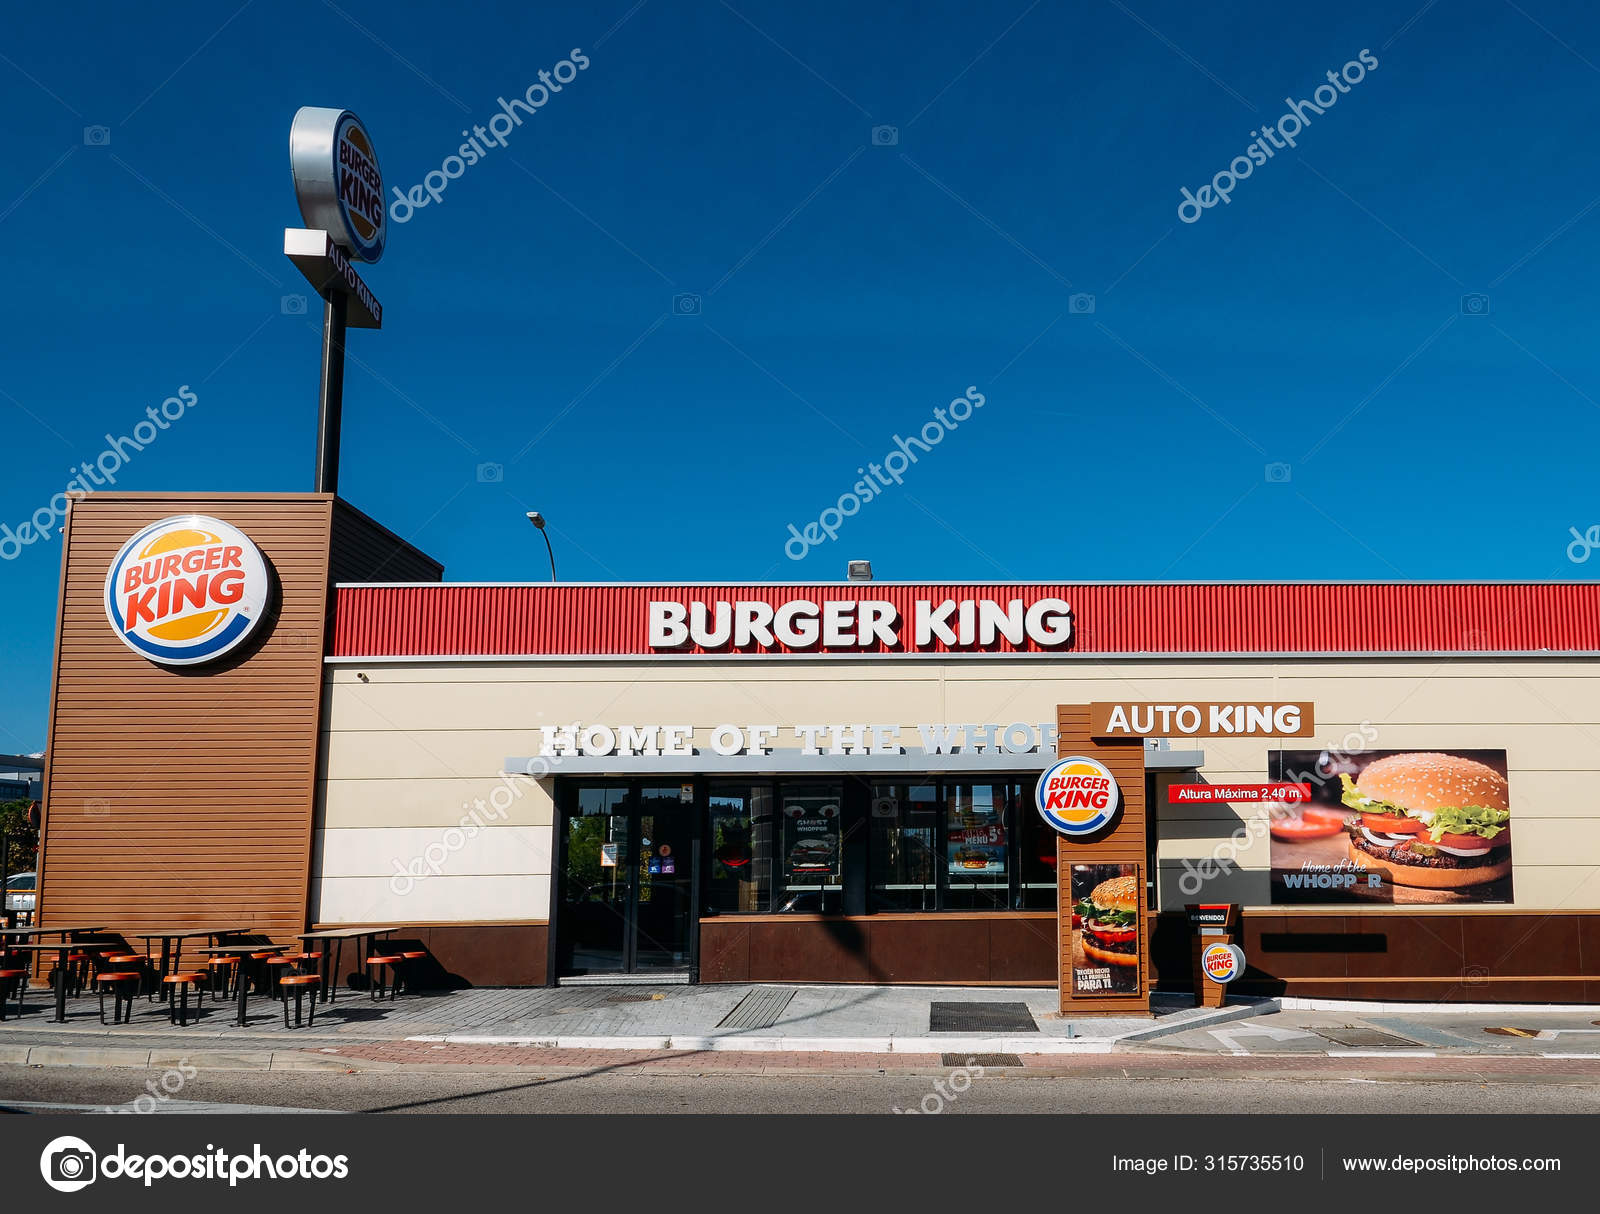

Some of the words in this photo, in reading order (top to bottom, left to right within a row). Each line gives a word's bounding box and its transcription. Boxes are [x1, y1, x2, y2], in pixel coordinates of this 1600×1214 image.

[339, 139, 381, 195] BURGER
[339, 167, 382, 229] KING
[328, 243, 356, 289] AUTO
[356, 281, 379, 320] KING
[123, 546, 243, 594] BURGER
[126, 569, 246, 631] KING
[648, 599, 898, 649] BURGER
[915, 598, 1071, 648] KING
[1105, 705, 1202, 733] AUTO
[1209, 705, 1301, 733] KING
[540, 724, 693, 756] HOME
[710, 724, 779, 756] OF
[795, 724, 901, 755] THE
[1048, 776, 1110, 791] BURGER
[1178, 789, 1212, 799] Altura
[1214, 788, 1258, 799] Máxima
[1261, 787, 1286, 800] 2,40
[1288, 788, 1303, 799] m.
[1045, 790, 1110, 809] KING
[1301, 859, 1331, 873] Home
[1333, 859, 1347, 874] of
[1347, 857, 1367, 873] the
[1283, 873, 1382, 889] WHOPPR
[1206, 953, 1232, 963] BURGER
[1207, 960, 1233, 972] KING
[1078, 979, 1102, 990] PARA
